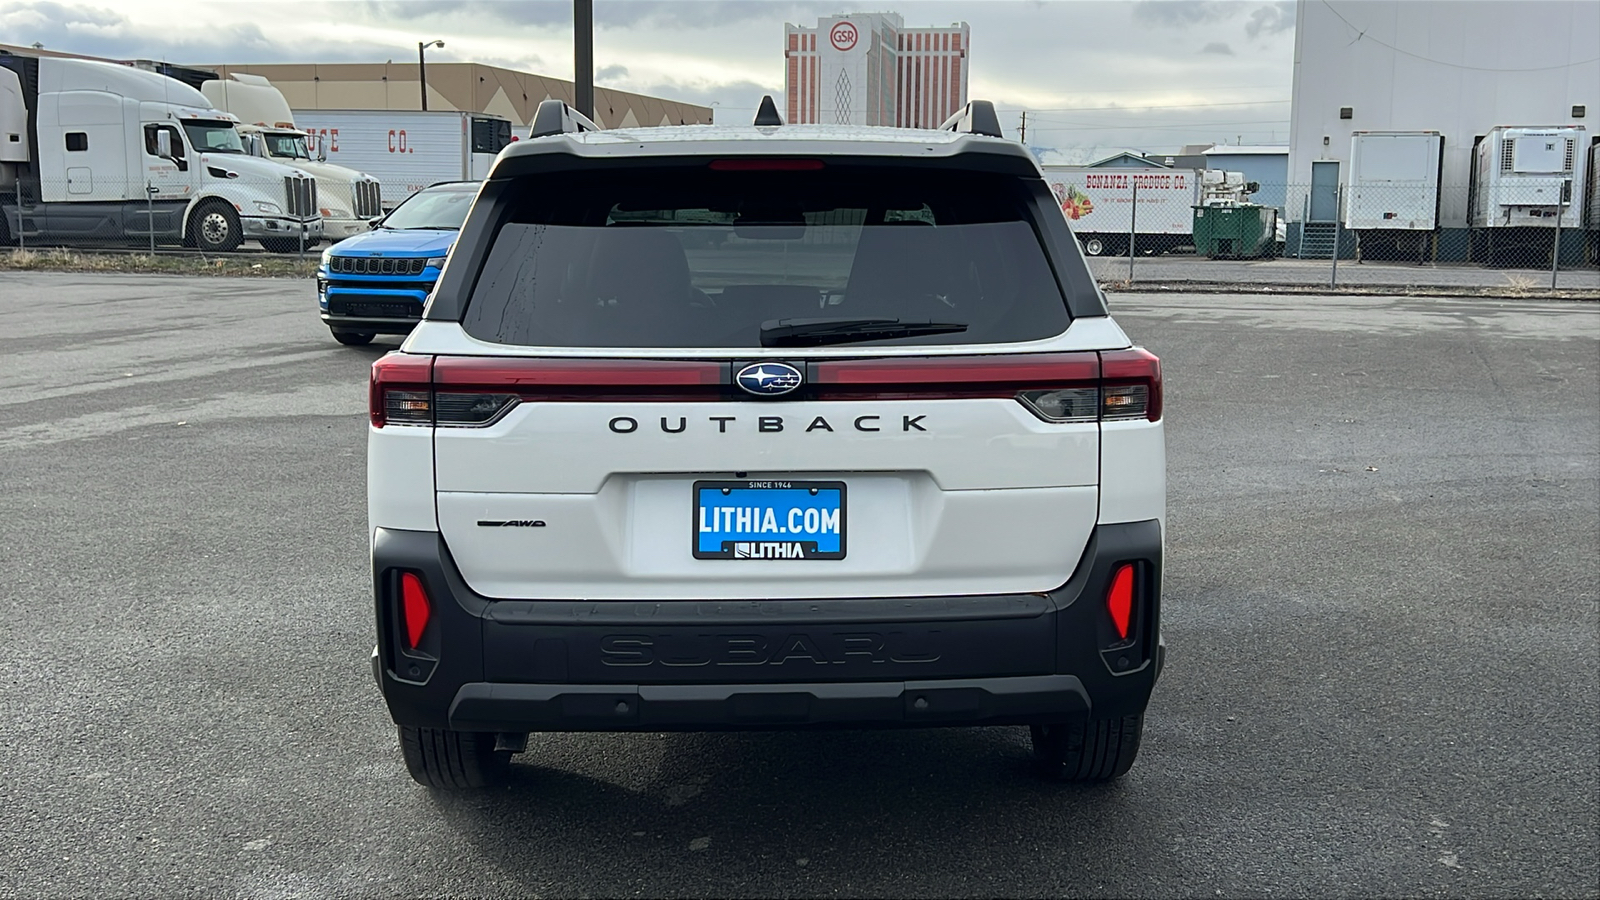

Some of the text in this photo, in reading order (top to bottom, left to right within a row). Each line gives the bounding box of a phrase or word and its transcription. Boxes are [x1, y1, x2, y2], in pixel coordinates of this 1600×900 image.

[833, 30, 854, 42] GSR
[388, 129, 413, 153] CO.
[1086, 174, 1187, 190] BONANZA PRODUCE CO.
[609, 414, 928, 434] OUTBACK
[748, 481, 792, 489] SINCE 1946
[699, 506, 840, 534] LITHIA.COM
[750, 542, 804, 558] LITHIA
[599, 629, 942, 667] SUBARU
